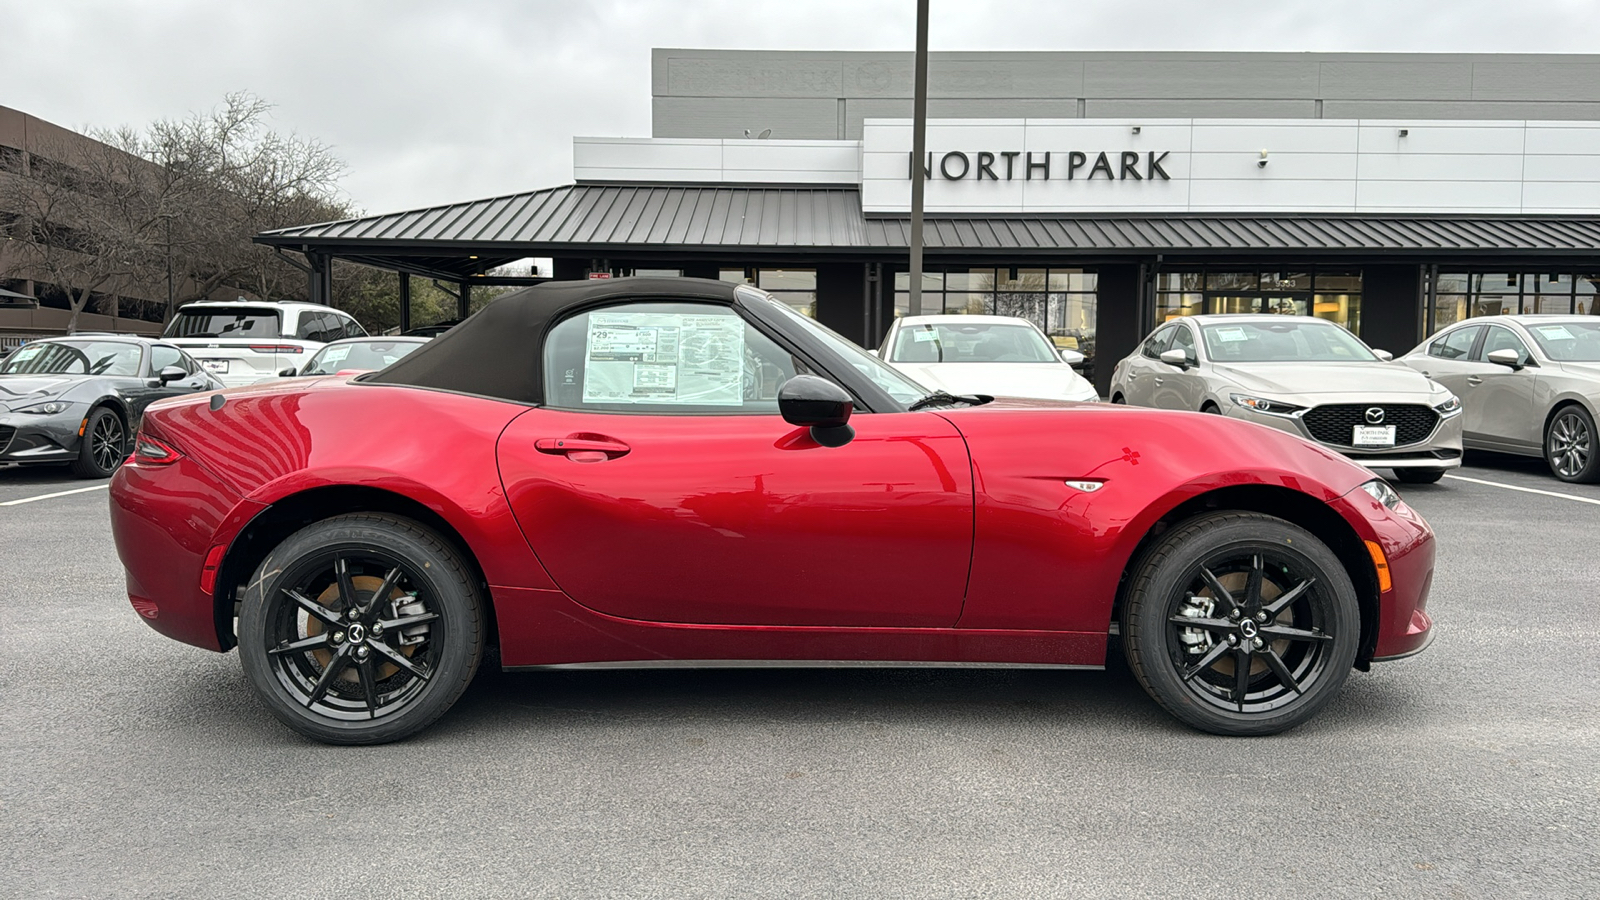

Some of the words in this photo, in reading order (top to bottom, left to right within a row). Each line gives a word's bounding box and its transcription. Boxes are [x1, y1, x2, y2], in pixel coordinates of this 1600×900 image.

[908, 150, 1051, 181] NORTH
[1067, 150, 1171, 181] PARK
[596, 331, 608, 339] 29
